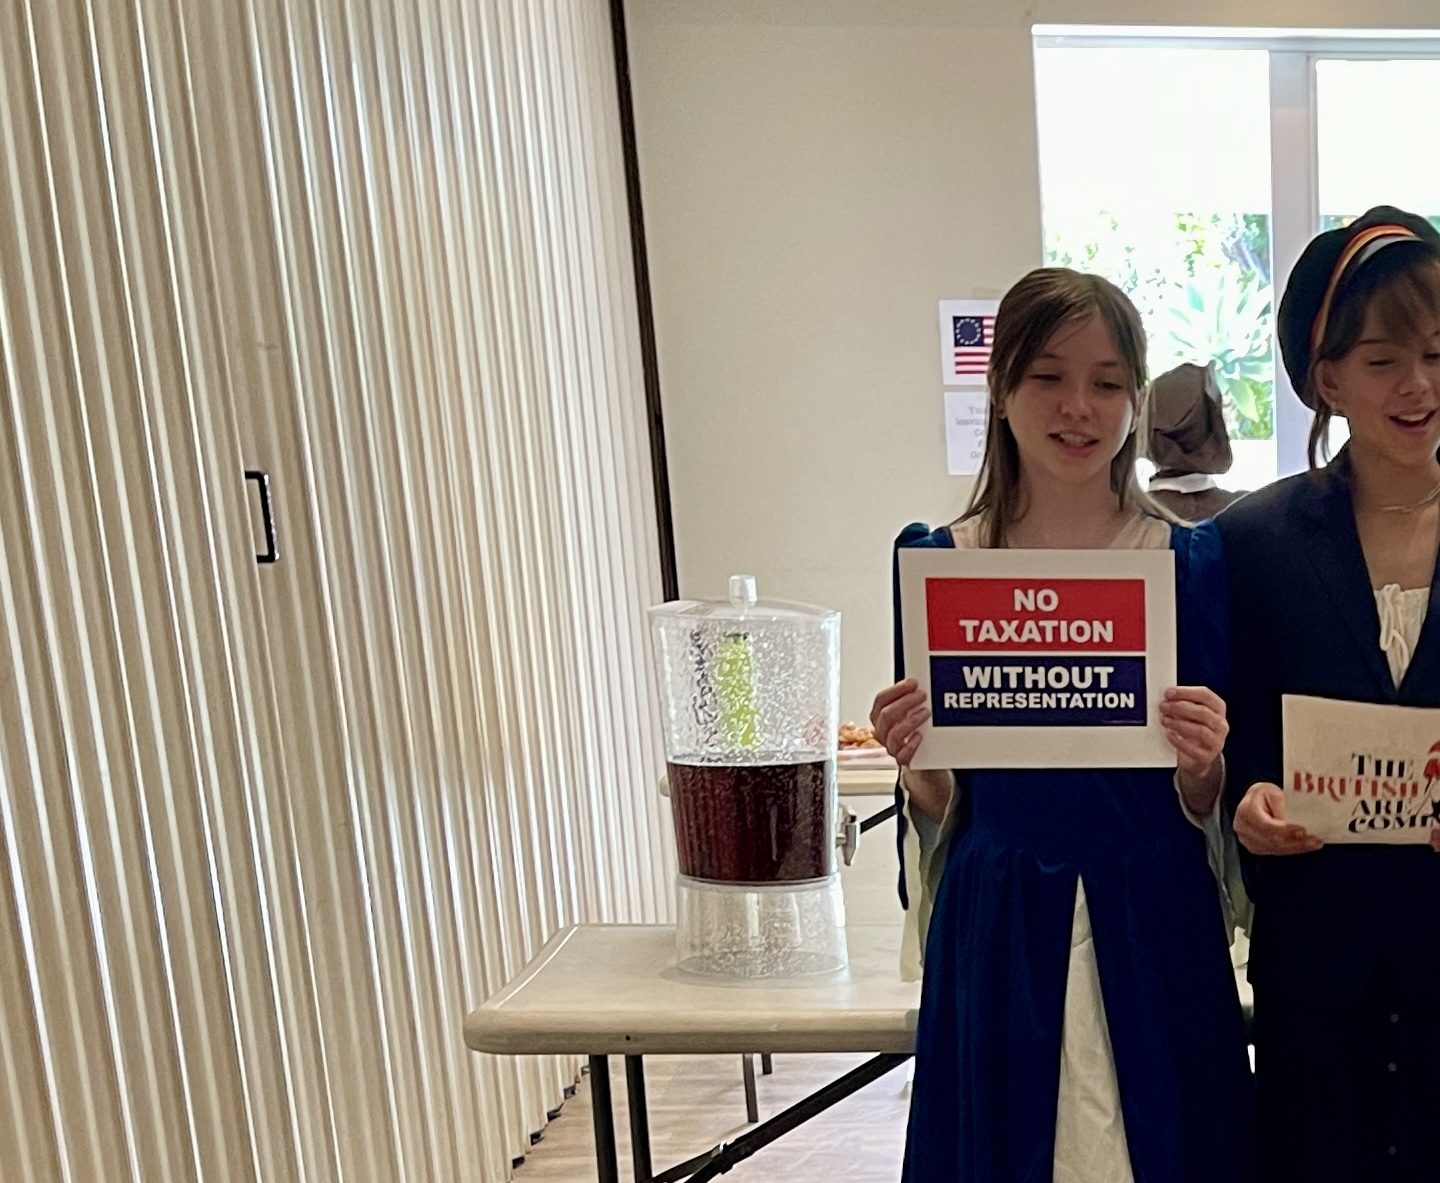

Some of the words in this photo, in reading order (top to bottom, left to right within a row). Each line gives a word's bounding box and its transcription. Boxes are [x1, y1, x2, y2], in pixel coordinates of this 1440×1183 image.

[1013, 588, 1060, 613] NO
[958, 619, 1115, 643] TAXATION
[962, 665, 1115, 689] WITHOUT
[943, 692, 1136, 709] REPRESENTATION
[1351, 752, 1414, 780] THE
[1293, 770, 1419, 802] BRITISH
